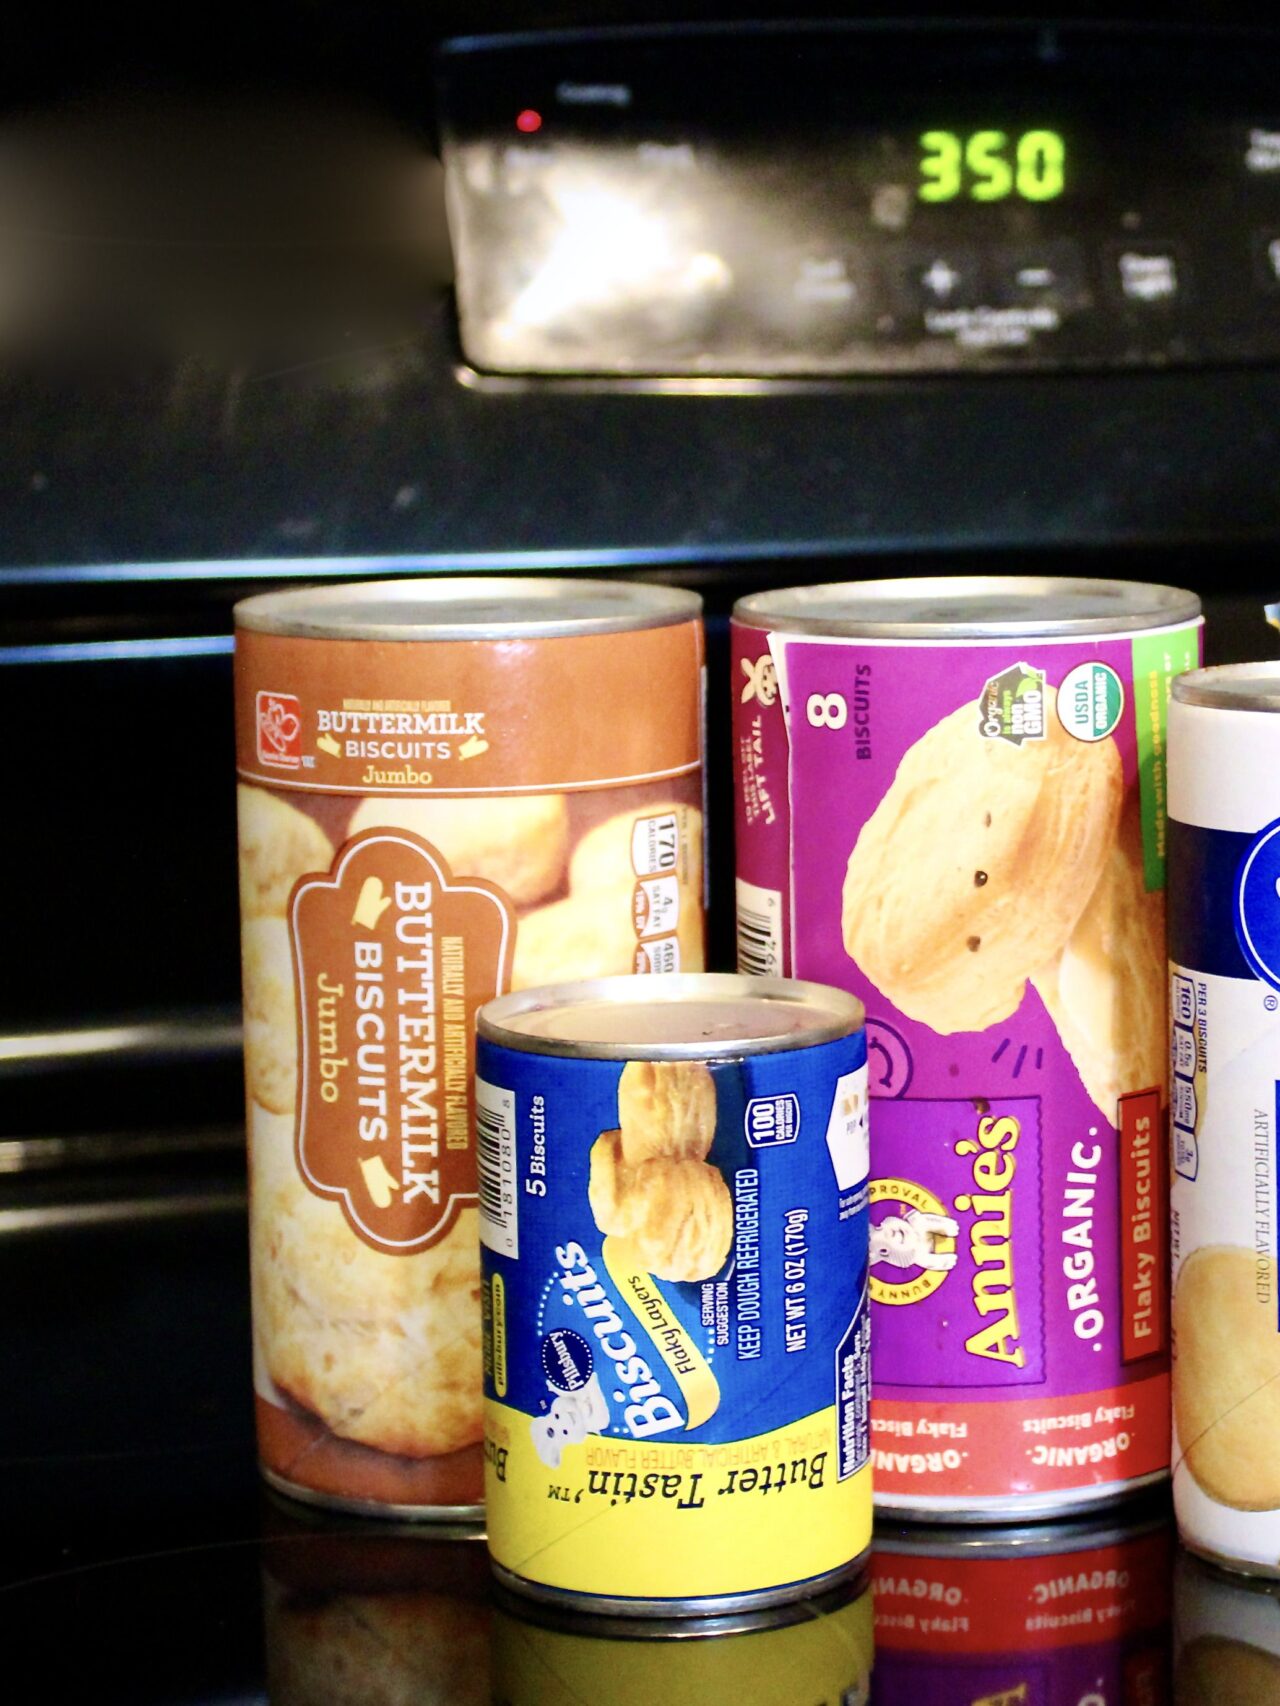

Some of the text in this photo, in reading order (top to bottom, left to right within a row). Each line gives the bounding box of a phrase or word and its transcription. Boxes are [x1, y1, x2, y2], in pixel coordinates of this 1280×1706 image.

[917, 130, 1065, 201] 350
[317, 711, 485, 735] BUTTERMILK
[806, 692, 849, 731] 8
[856, 664, 872, 761] BISCUITS
[983, 681, 1002, 736] Organic
[1011, 704, 1024, 734] non
[1024, 690, 1042, 734] GMO
[1074, 679, 1088, 724] USDA
[1093, 671, 1107, 730] ORGANIC
[345, 740, 451, 759] BISCUITS
[362, 765, 433, 785] Jumbo
[751, 714, 775, 825] LIFT TAIL
[658, 820, 675, 868] 170
[1181, 986, 1191, 1019] 160
[1198, 983, 1207, 1006] PER
[316, 972, 347, 1104] Jumbo
[354, 941, 388, 1143] BISCUITS
[394, 881, 440, 1205] BUTTERMILK
[441, 936, 469, 1150] NATURALLY AND ARTIFICIALLY FLAVORED
[1198, 1018, 1207, 1073] BISCUITS
[526, 1095, 547, 1196] 5 Biscuits
[752, 1103, 775, 1140] 100
[775, 1099, 785, 1140] CALORIES
[502, 1129, 513, 1218] 181080
[869, 1184, 928, 1209] PROVAL
[1132, 1115, 1157, 1340] Flaky Biscuits
[1254, 1109, 1270, 1304] ARTIFICIALLY FLAVORED
[735, 1169, 761, 1360] KEEP DOUGH REFRIGERATED
[955, 1114, 1026, 1369] Annie's
[702, 1283, 714, 1329] SERVING
[784, 1209, 808, 1352] NET WT 6 OZ (170g)
[879, 1279, 932, 1300] BUNNY
[555, 1240, 686, 1438] Biscuits
[628, 1275, 696, 1374] Flaky Layers
[716, 1281, 728, 1346] SUGGESTION
[551, 1331, 584, 1391] Pillsbury
[841, 1354, 856, 1473] Nutrition Facts
[916, 1418, 968, 1438] Flaky
[1022, 1403, 1135, 1436] Flaky Biscuits
[642, 1448, 694, 1469] BUTTER
[718, 1452, 828, 1495] Butter
